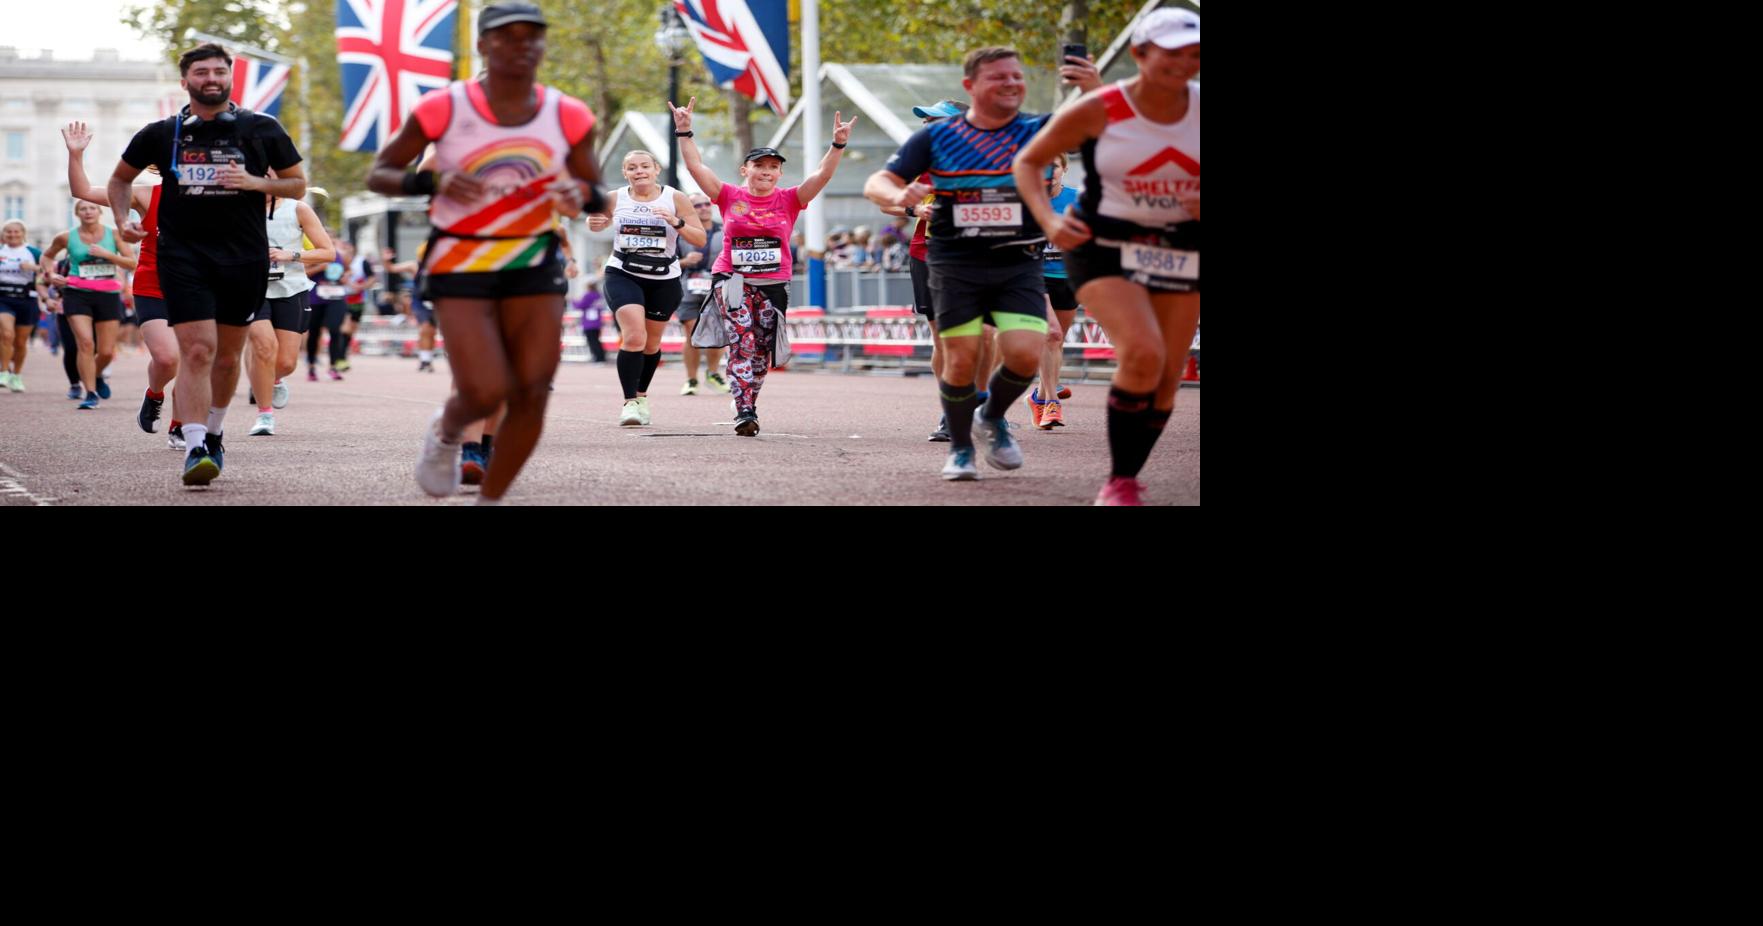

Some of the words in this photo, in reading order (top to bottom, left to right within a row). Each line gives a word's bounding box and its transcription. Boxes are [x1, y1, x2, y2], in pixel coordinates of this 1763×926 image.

[961, 207, 1012, 222] 35593
[626, 237, 659, 247] 13591
[738, 251, 775, 262] 12025
